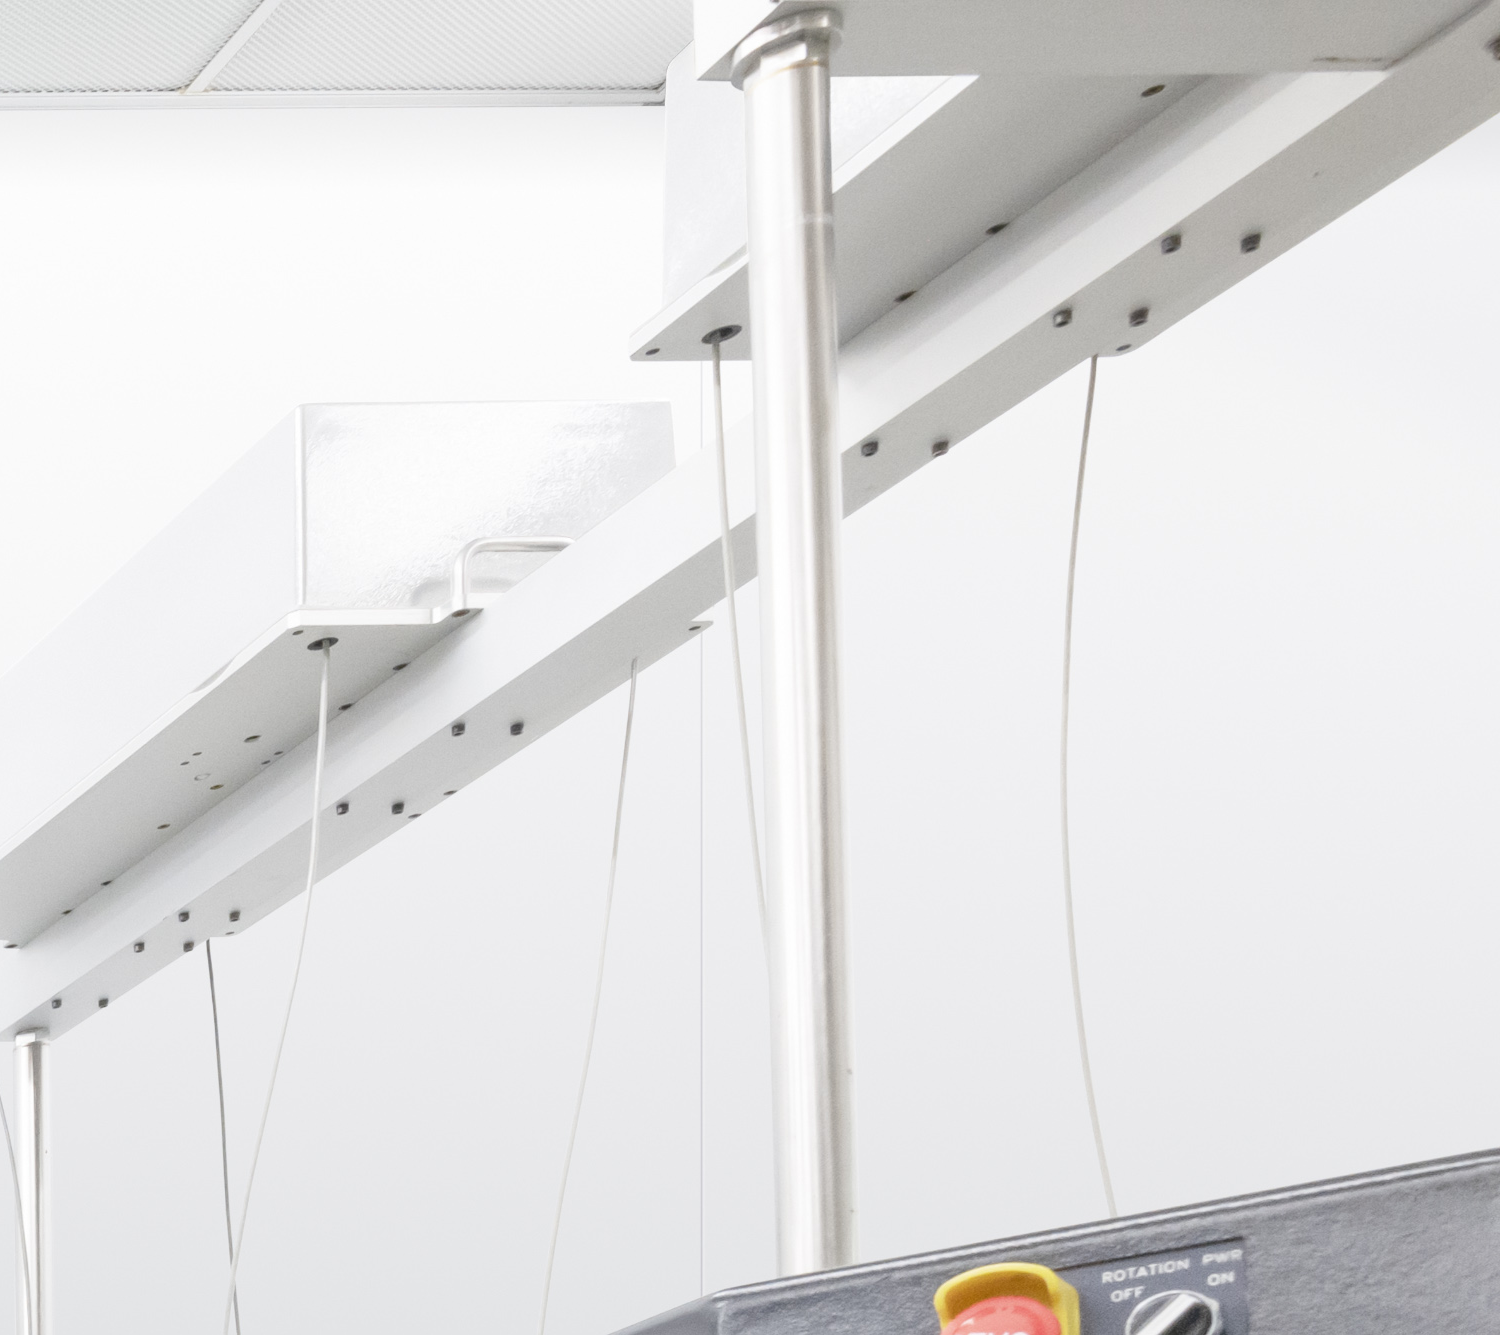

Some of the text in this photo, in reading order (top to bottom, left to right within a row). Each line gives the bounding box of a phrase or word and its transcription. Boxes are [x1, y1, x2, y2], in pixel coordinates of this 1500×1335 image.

[1102, 1249, 1243, 1285] ROTATION PWR
[1110, 1271, 1235, 1302] OFF ON
